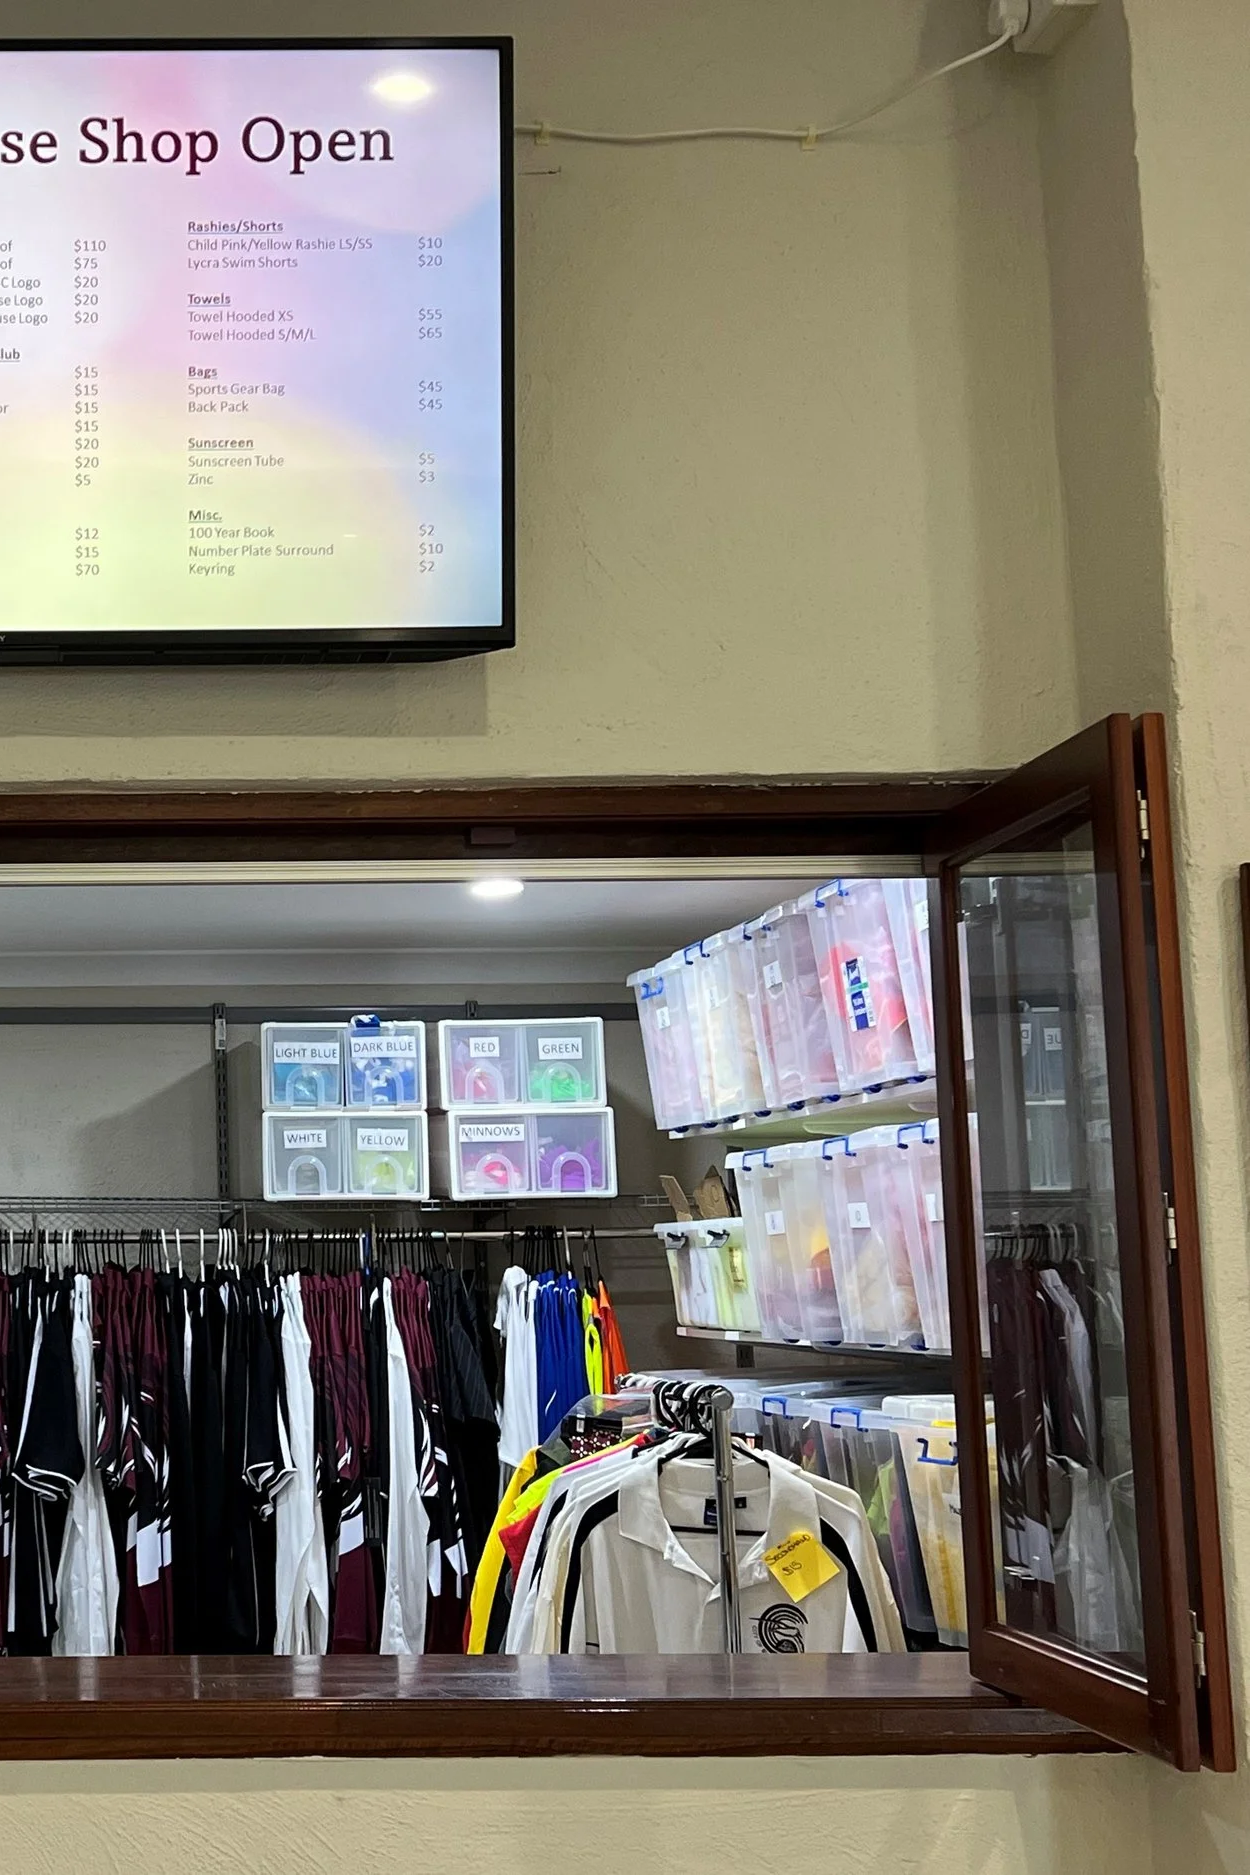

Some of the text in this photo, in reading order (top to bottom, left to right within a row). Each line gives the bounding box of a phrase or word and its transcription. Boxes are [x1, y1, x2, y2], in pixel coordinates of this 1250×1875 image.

[77, 116, 219, 175] Shop
[240, 116, 394, 175] Open
[188, 220, 283, 234] Rashies/Shorts
[187, 236, 442, 252] Child Pink/Yellow Rashie LS/SS $10
[74, 257, 98, 271] $75
[187, 254, 442, 271] Lycra Swim Shorts $20
[11, 277, 41, 290] Logo
[74, 275, 98, 289] $20
[188, 293, 231, 306] Towels
[187, 326, 442, 342] Towel Hooded S/M/L $65
[75, 365, 98, 380] $15
[187, 366, 218, 380] Bags
[75, 383, 98, 397] $15
[188, 380, 442, 397] Sports Gear Bag $45
[187, 398, 442, 413] Back Pack $45
[75, 419, 98, 433] $15
[75, 437, 99, 451] $20
[188, 438, 253, 451] Sunscreen
[75, 456, 99, 469] $20
[187, 453, 435, 468] Sunscreen Tube $5
[187, 470, 435, 486] Zinc $3
[188, 509, 223, 523] Misc.
[75, 528, 99, 541] $12
[188, 524, 435, 540] 100 Year Book $2
[75, 545, 99, 559] $15
[188, 542, 443, 558] Number Plate Surround $10
[76, 563, 100, 576] $70
[189, 559, 435, 576] Keyring $2
[275, 1047, 338, 1059] LIGHT BLUE
[353, 1041, 414, 1053] DARK BLUE
[473, 1042, 496, 1053] RED
[542, 1043, 580, 1055] GREEN
[286, 1132, 323, 1144] WHITE
[461, 1126, 521, 1137] MINNOWS
[360, 1134, 406, 1146] YELLOW
